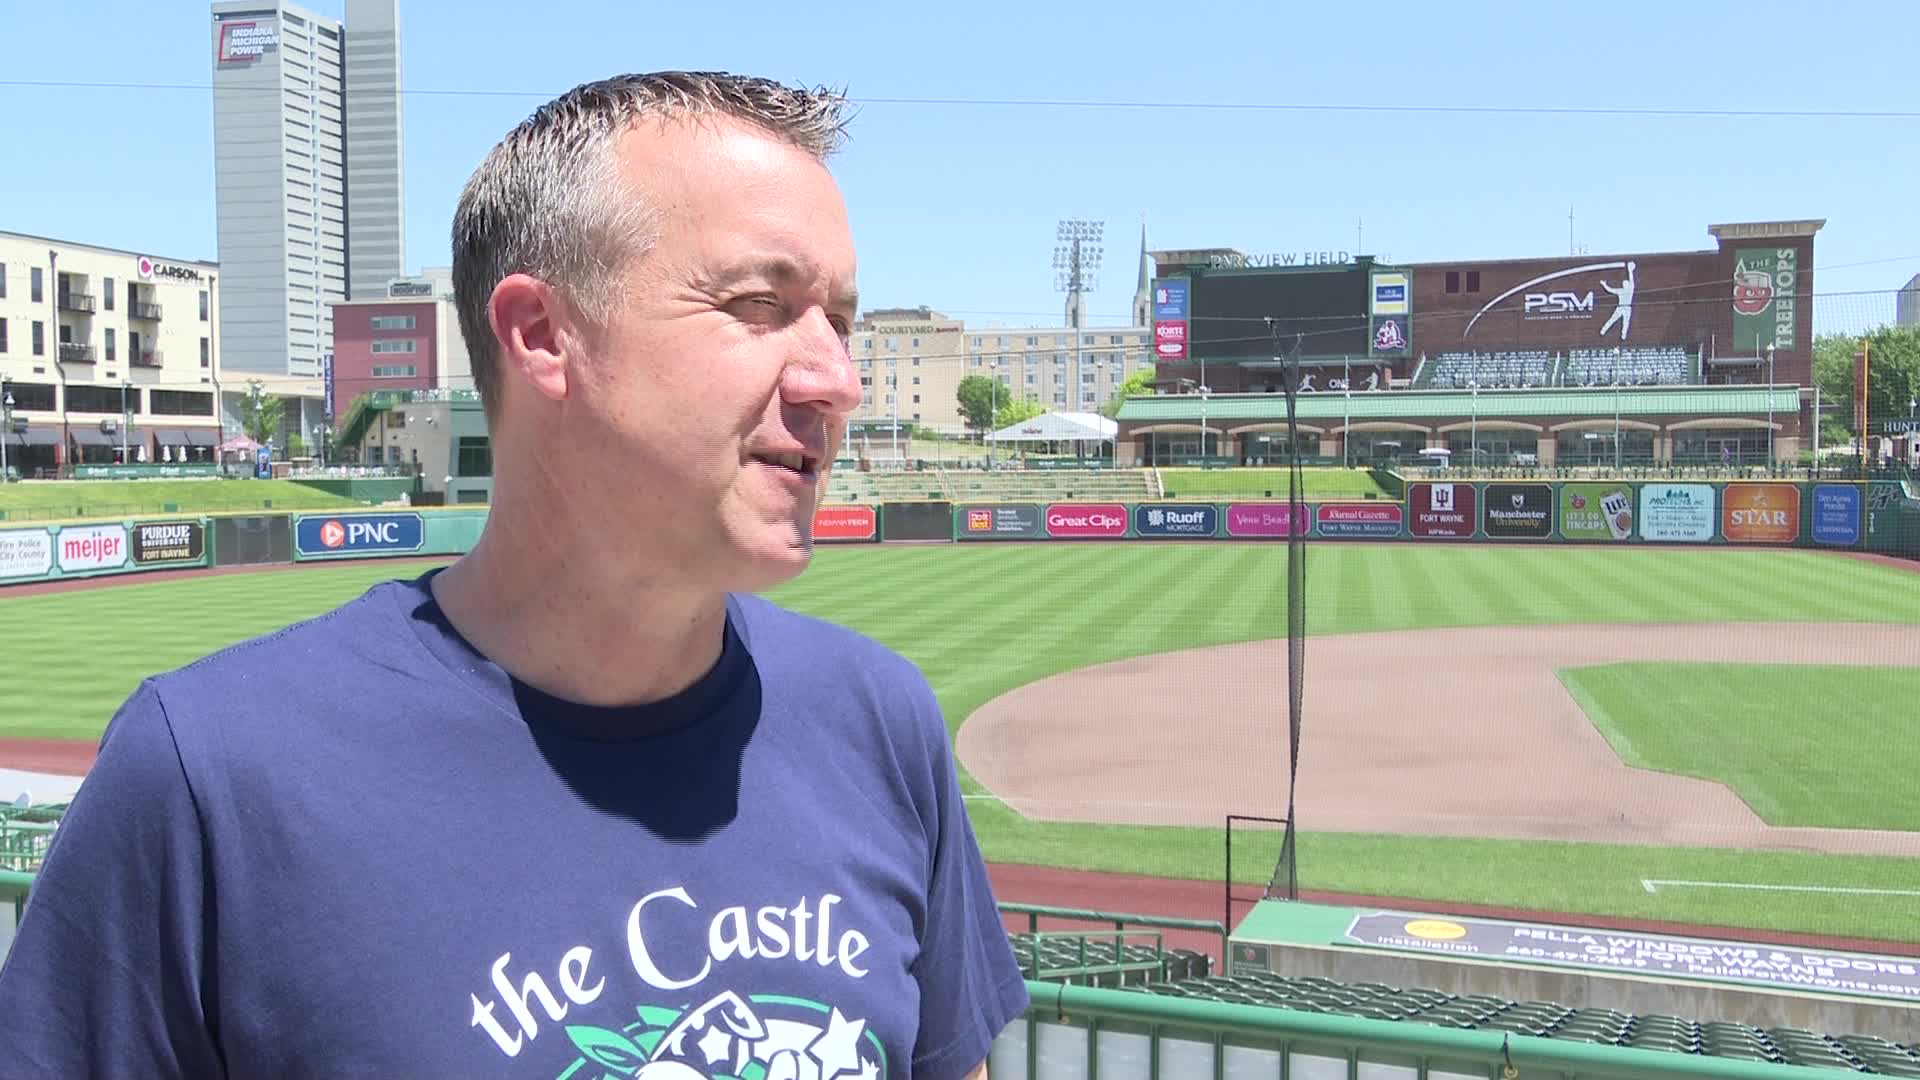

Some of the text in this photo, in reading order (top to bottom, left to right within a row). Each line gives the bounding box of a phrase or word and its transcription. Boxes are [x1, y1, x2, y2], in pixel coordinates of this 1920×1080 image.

[232, 27, 273, 37] INDIANA
[231, 35, 280, 46] MICHIGAN
[230, 45, 264, 56] POWER
[1210, 251, 1348, 269] PARKVIEW FIELD
[1750, 258, 1770, 269] THE
[153, 264, 199, 280] CARSON
[1525, 291, 1594, 313] PSM
[1776, 248, 1794, 348] TREETOPS
[879, 326, 933, 335] COURTYARD
[1157, 326, 1184, 336] KORTE
[1166, 511, 1205, 524] Ruoff
[1358, 510, 1391, 520] Gazette
[1420, 514, 1464, 523] FORT WAYNE
[1489, 510, 1547, 519] Manchester
[1731, 509, 1787, 526] STAR
[847, 519, 869, 527] TECH
[1049, 514, 1088, 527] Great
[1089, 513, 1121, 530] Clips
[1495, 519, 1539, 528] University
[141, 525, 191, 539] PURDUE
[347, 522, 399, 544] PNC
[1166, 524, 1205, 532] MORTGAGE
[64, 531, 120, 562] meijer
[141, 538, 190, 547] UNIVERSITY
[142, 550, 160, 560] FORT
[1513, 927, 1917, 976] PELLA WINDOWS & DOORS
[1584, 945, 1836, 978] OF FORT WAYNE
[471, 886, 870, 1057] the Castle
